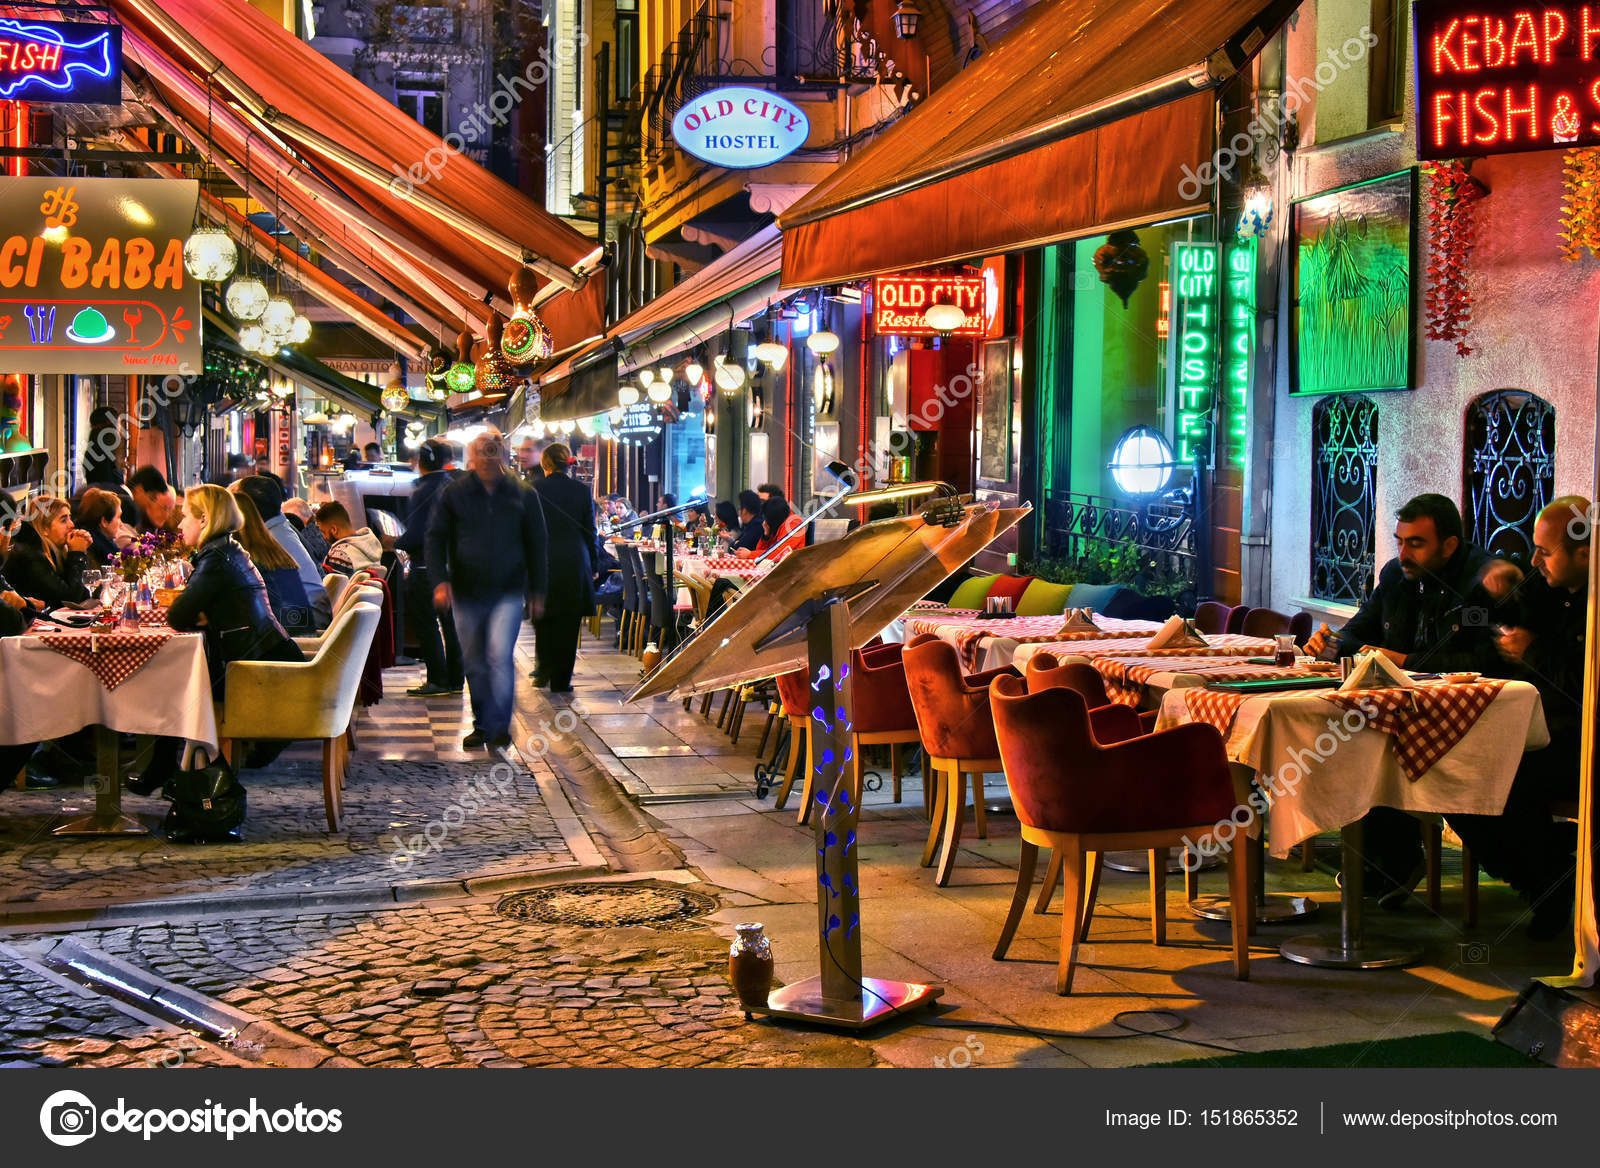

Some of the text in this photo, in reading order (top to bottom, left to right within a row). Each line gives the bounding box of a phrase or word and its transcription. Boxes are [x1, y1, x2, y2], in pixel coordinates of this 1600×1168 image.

[1434, 10, 1565, 74] KEBAP
[684, 98, 802, 132] OLD CITY
[1436, 86, 1536, 145] FISH
[1552, 95, 1578, 134] &
[705, 135, 779, 149] HOSTEL
[60, 236, 184, 290] BABA
[1181, 249, 1214, 271] OLD
[882, 284, 925, 307] OLD
[1180, 274, 1213, 297] CITY
[879, 310, 982, 328] Restant
[121, 353, 149, 365] Since
